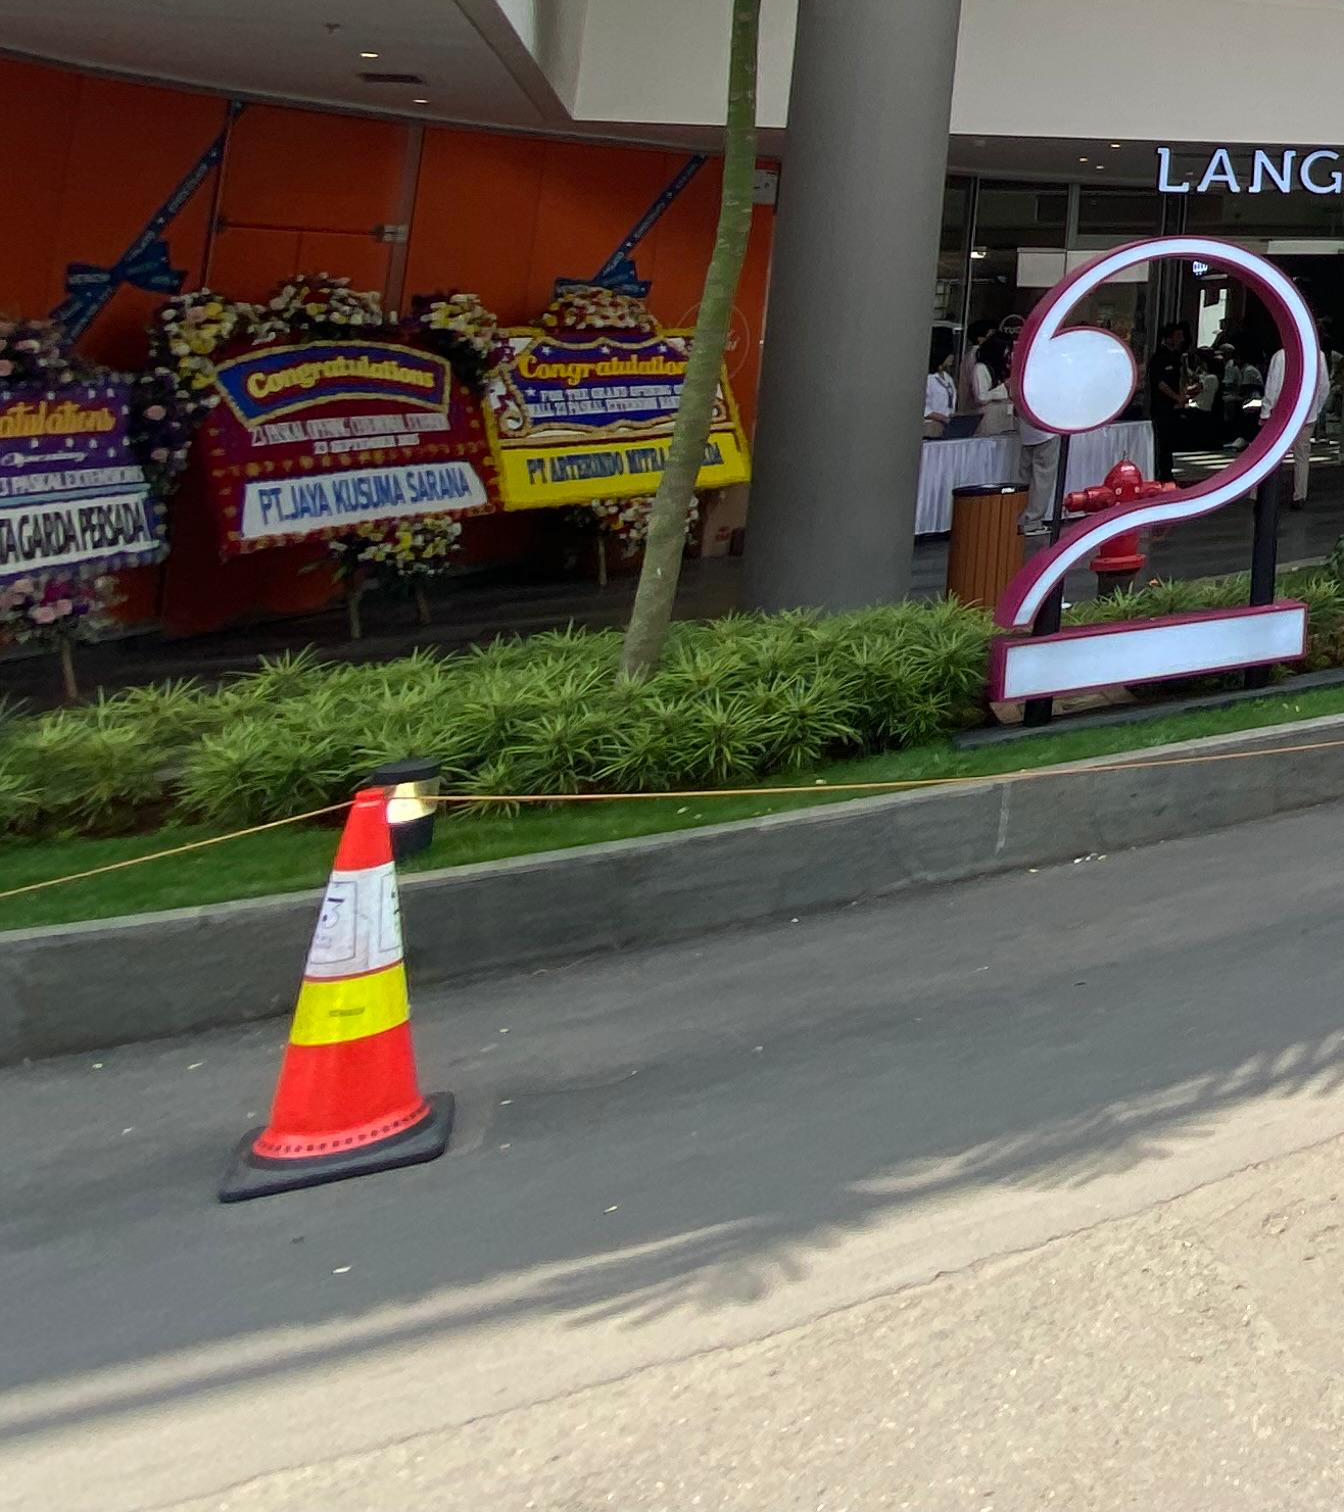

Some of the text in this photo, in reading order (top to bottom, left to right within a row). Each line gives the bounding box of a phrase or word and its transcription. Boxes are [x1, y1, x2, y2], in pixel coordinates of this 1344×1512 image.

[247, 355, 435, 399] Congratulations
[331, 473, 406, 514] KUSUMA
[405, 466, 472, 505] SARANA
[18, 509, 82, 561] GARDA
[78, 498, 151, 552] PERSADA
